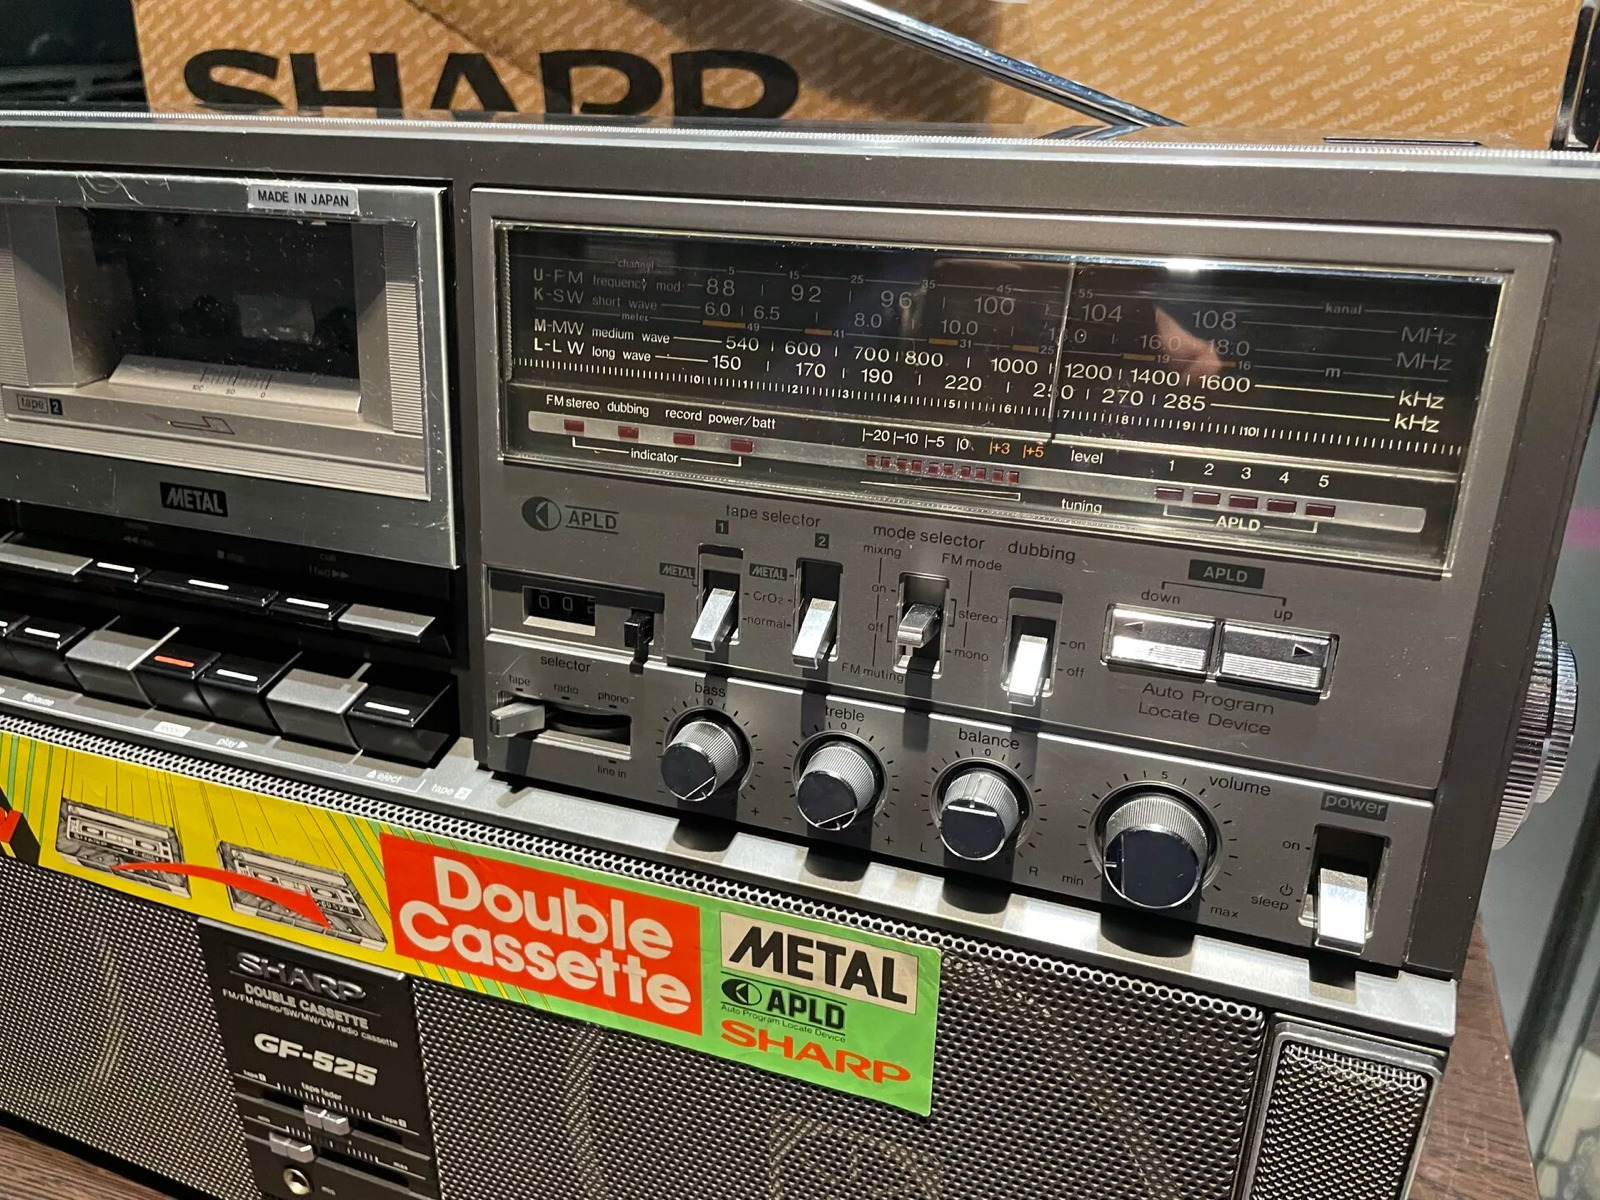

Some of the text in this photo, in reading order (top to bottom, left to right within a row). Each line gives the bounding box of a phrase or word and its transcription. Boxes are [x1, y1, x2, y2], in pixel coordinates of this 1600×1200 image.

[184, 48, 800, 120] SHARP
[257, 188, 350, 208] MADE IN JAPAN
[533, 267, 584, 285] U-FM
[592, 274, 648, 292] frequency
[705, 278, 736, 297] 88
[790, 284, 822, 303] 92
[880, 289, 914, 309] 96
[973, 295, 1016, 316] 100
[1079, 303, 1123, 323] 104
[1191, 309, 1238, 331] 108
[1401, 325, 1458, 346] MHz
[850, 274, 1363, 315] 25 35 45 55 kanal
[533, 286, 585, 305] K-SW
[591, 294, 621, 308] short
[627, 299, 658, 312] wave
[704, 301, 732, 318] 6.0
[753, 305, 781, 321] 6.5
[853, 312, 883, 329] 8.0
[940, 318, 979, 336] 10.0
[1140, 333, 1182, 351] 16.0
[1396, 351, 1453, 371] MHz
[621, 312, 1341, 379] meter 49 41 31 25 19 16 m
[533, 318, 1446, 410] M-MW medium wave 540 600 700 800 1000 1200 1400 1600 kHz
[533, 338, 1441, 434] L-LW long wave 150 170 190 220 270 285 kHz
[21, 397, 62, 414] tape 2
[545, 394, 777, 431] FM stereo dubbing record power/batt
[630, 448, 679, 463] indicator
[1070, 449, 1104, 465] level
[1168, 460, 1330, 489] 1 2 3 4 5
[165, 487, 224, 514] METAL
[566, 509, 618, 531] APLD
[725, 503, 822, 529] tape selector
[1060, 498, 1261, 532] tuning APLD
[873, 524, 986, 550] mode selector
[862, 543, 1003, 572] mixing FM mode
[1007, 540, 1077, 565] dubbing
[661, 564, 787, 581] METAL METAL
[1203, 565, 1249, 584] APLD
[871, 583, 887, 594] on
[958, 609, 999, 624] stereo
[1140, 588, 1293, 623] down up
[746, 614, 788, 630] normal
[867, 621, 885, 632] off
[953, 649, 990, 662] mono
[1068, 640, 1086, 651] on
[539, 655, 591, 673] selector
[841, 662, 905, 685] FM muting
[1066, 666, 1086, 679] off
[508, 674, 630, 705] tape radio phono
[694, 681, 727, 698] bass
[1141, 682, 1275, 716] Auto Program
[825, 704, 866, 723] treble
[1138, 700, 1272, 736] Locate Device
[958, 727, 1020, 751] balance
[616, 769, 628, 779] in
[1208, 774, 1272, 797] volume
[1324, 793, 1387, 818] power
[1281, 839, 1301, 852] on
[433, 855, 674, 960] Double
[1061, 873, 1240, 920] min max
[1250, 893, 1290, 913] sleep
[398, 900, 693, 1016] Cassette
[728, 925, 908, 1005] METAL
[237, 951, 367, 1001] SHARP
[244, 983, 370, 1030] DOUBLE CASSETTE
[766, 988, 846, 1031] APLD
[721, 1003, 847, 1043] Auto Program Locate Device
[337, 1024, 360, 1037] radio
[361, 1031, 399, 1049] cassette
[253, 1033, 378, 1087] GF-525
[720, 1019, 911, 1085] SHARP
